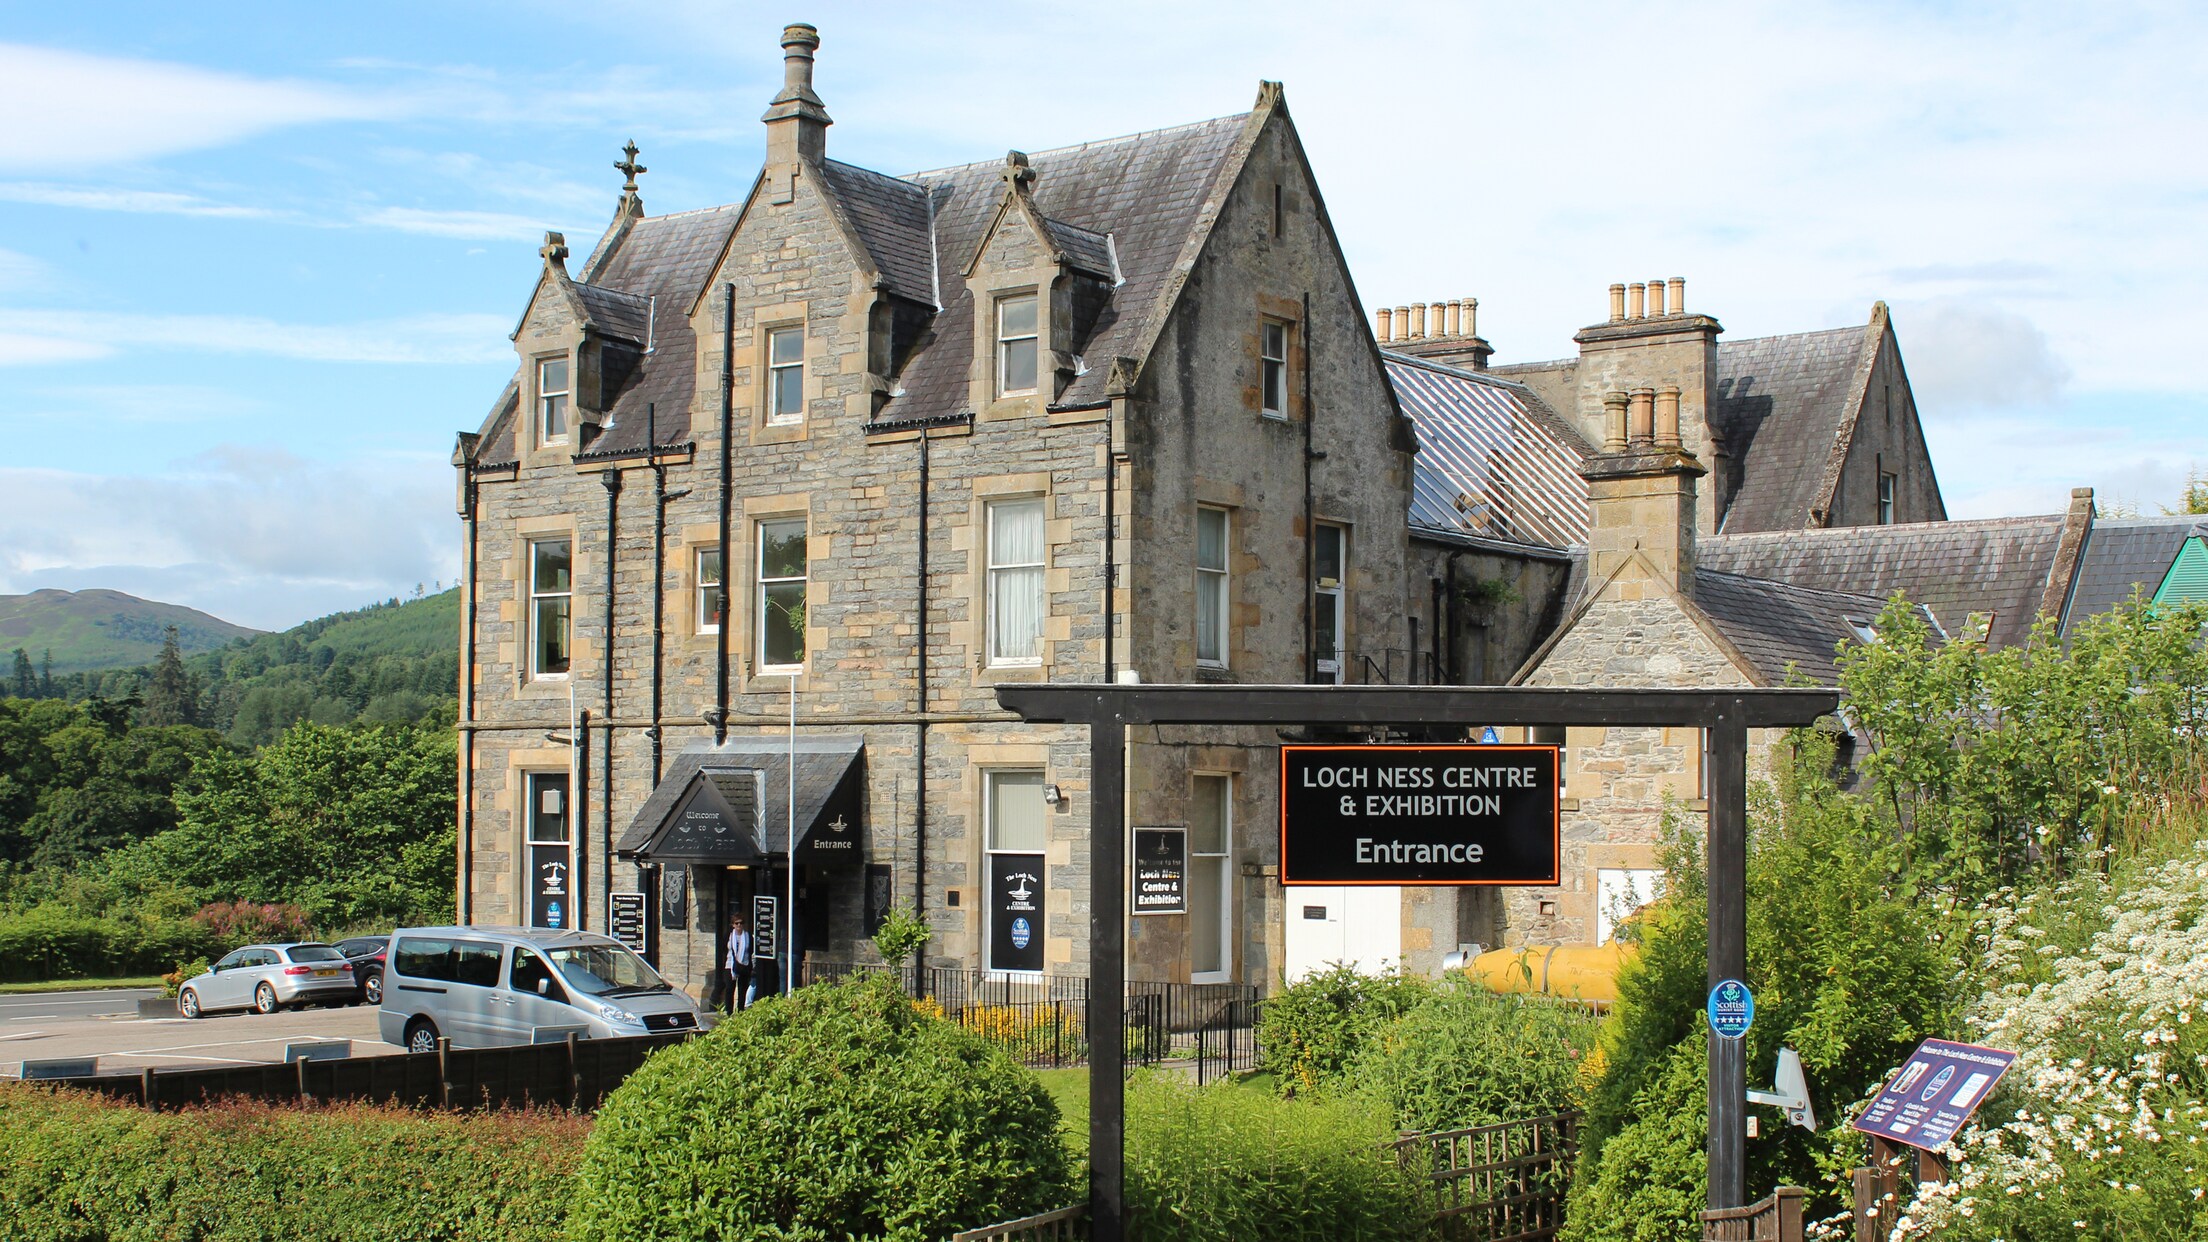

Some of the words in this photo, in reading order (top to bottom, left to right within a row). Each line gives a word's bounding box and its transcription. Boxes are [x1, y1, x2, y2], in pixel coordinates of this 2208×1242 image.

[1303, 767, 1368, 788] LOCH
[1377, 767, 1434, 788] NESS
[1442, 767, 1537, 788] CENTRE
[1340, 795, 1357, 816] &
[1366, 795, 1500, 816] EXHIBITION
[686, 811, 719, 819] Welcome
[814, 839, 852, 849] Entrance
[1356, 838, 1484, 863] Entrance
[1140, 869, 1160, 879] Loch
[1142, 881, 1170, 892] Centre
[1171, 881, 1178, 892] &
[1138, 894, 1182, 905] Exhibition
[1715, 1000, 1748, 1009] Scottish
